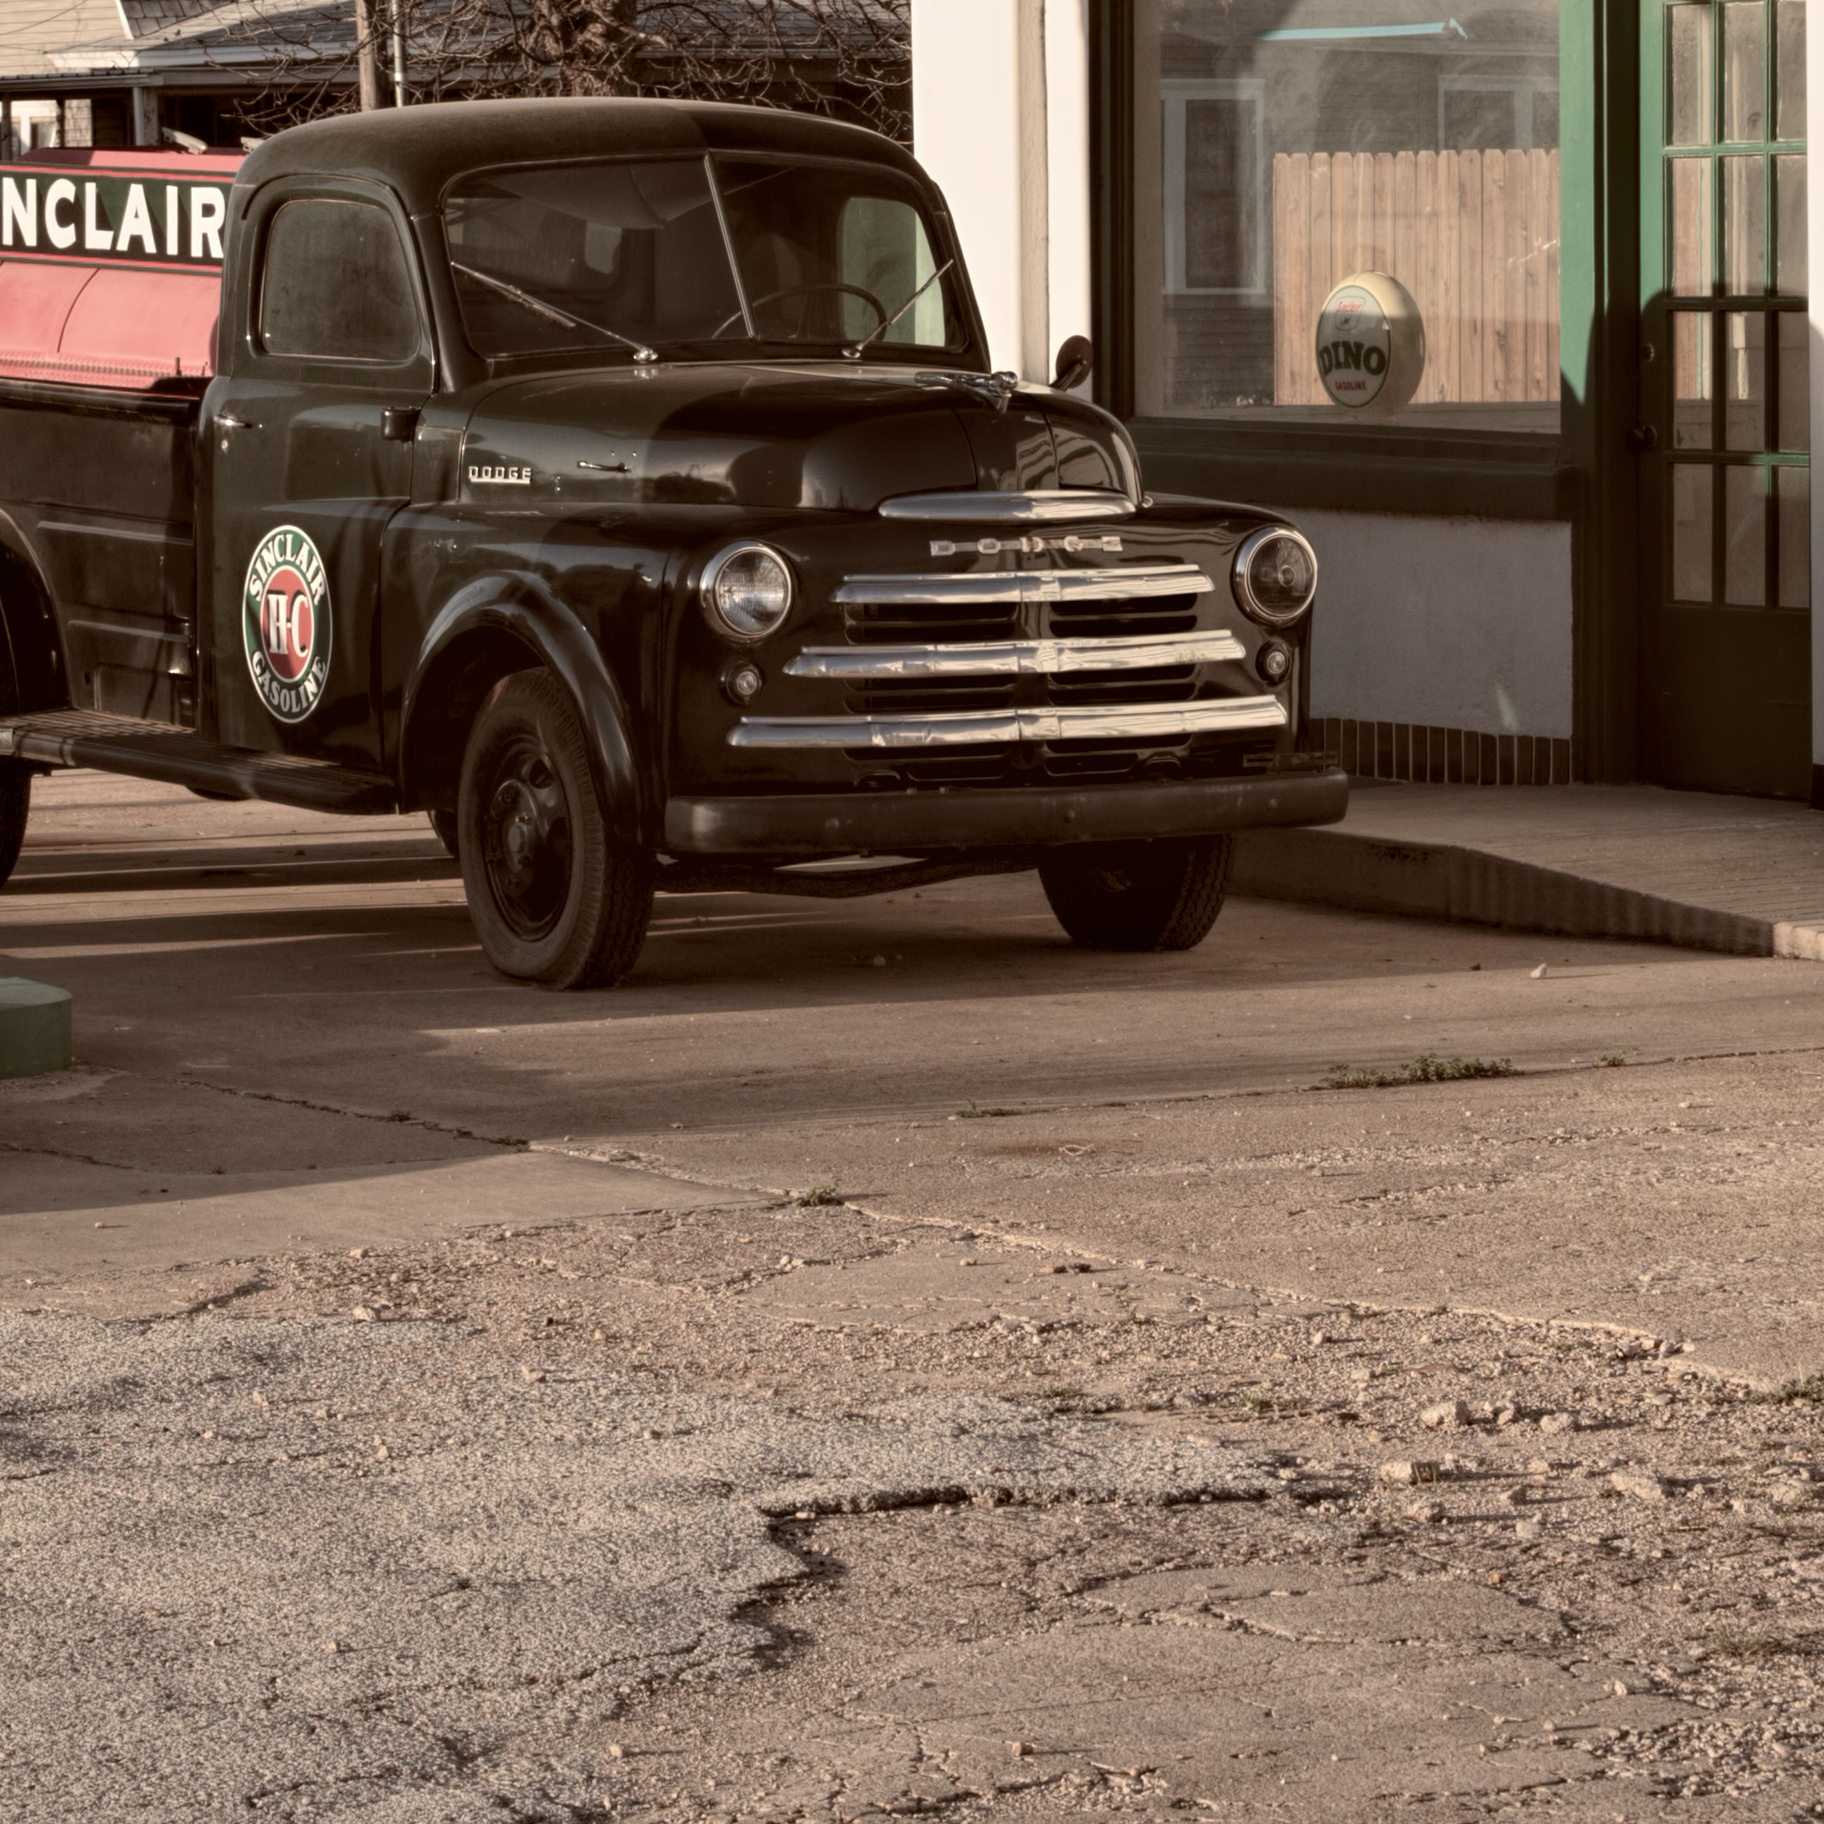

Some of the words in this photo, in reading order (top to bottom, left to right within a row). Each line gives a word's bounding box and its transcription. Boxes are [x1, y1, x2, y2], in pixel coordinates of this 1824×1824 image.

[1318, 340, 1387, 377] DINO
[1335, 380, 1367, 391] GASOLINE
[469, 465, 532, 480] DODGE
[249, 533, 326, 606] SINCLAIR
[267, 592, 309, 658] H-C
[252, 650, 326, 713] GASOLINE
